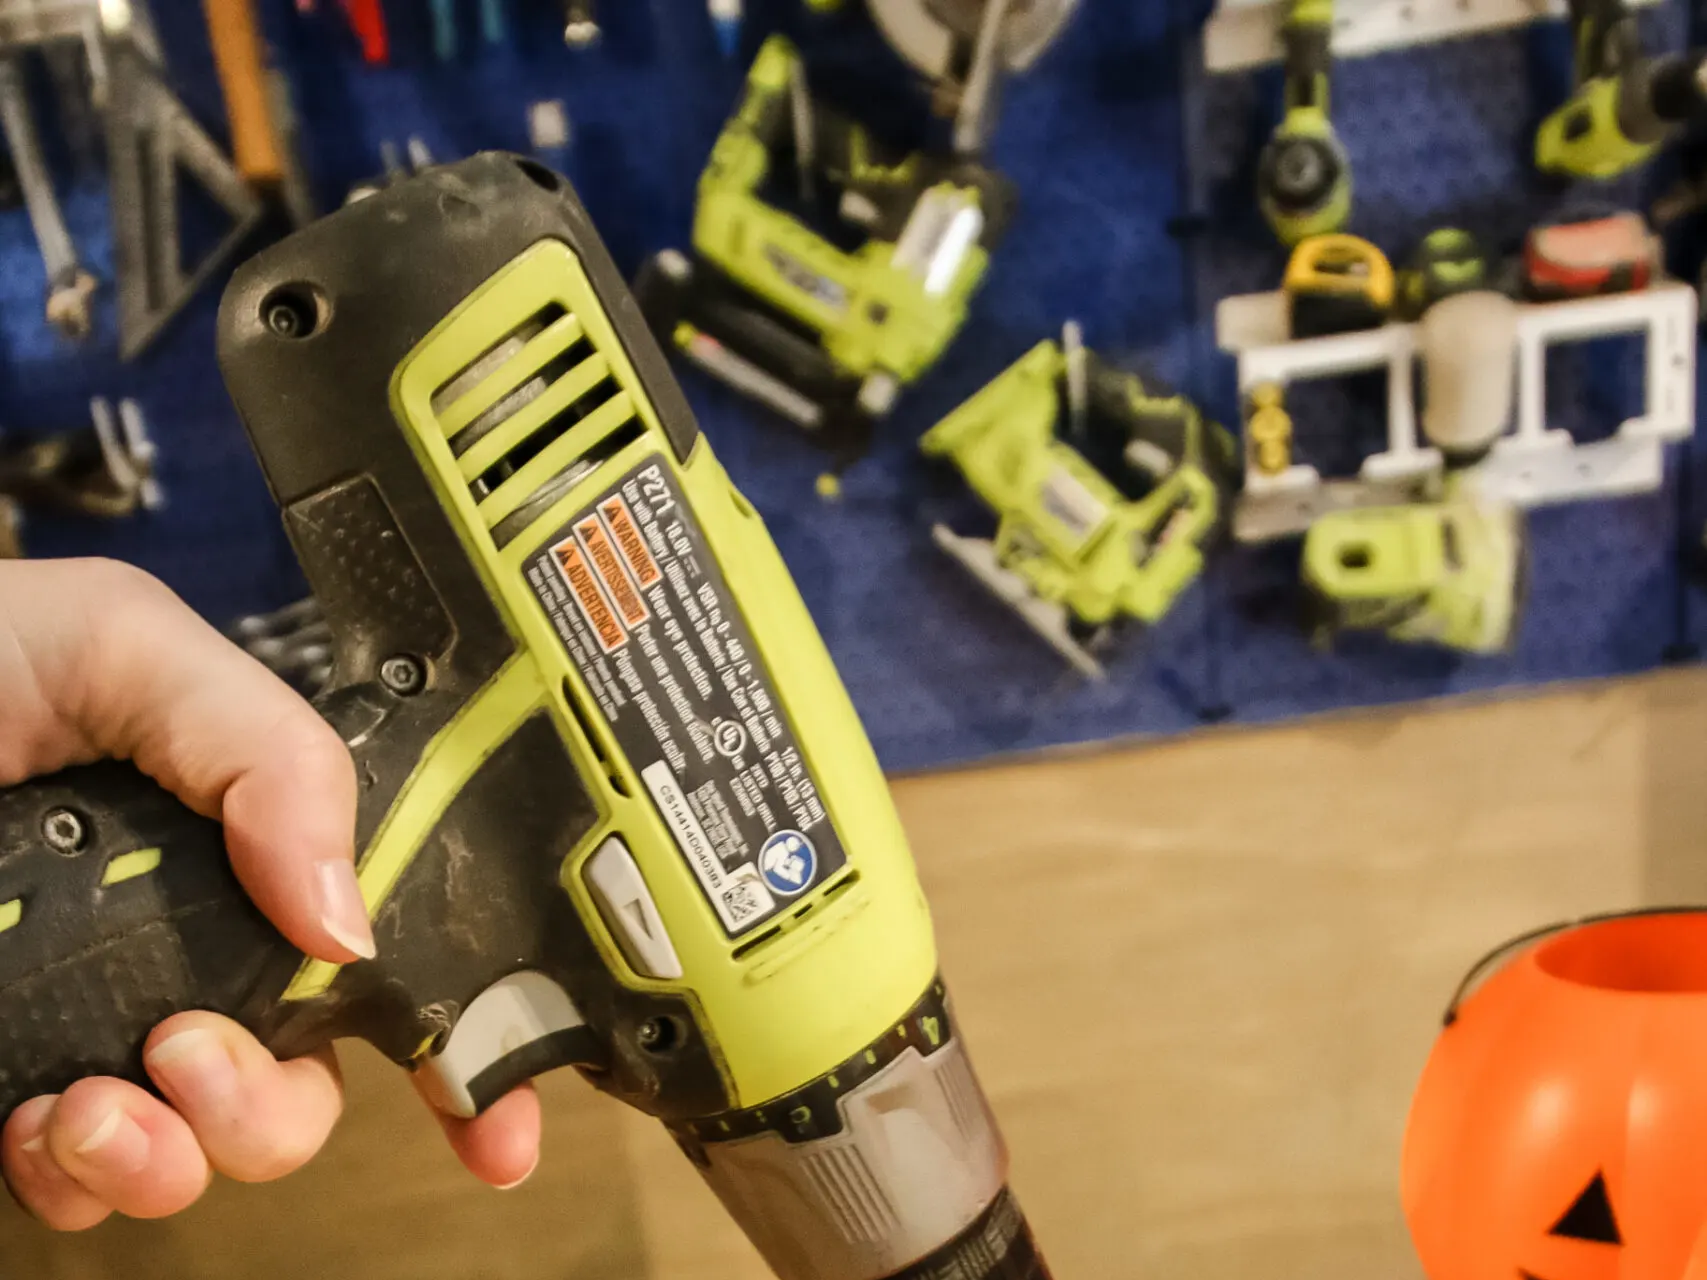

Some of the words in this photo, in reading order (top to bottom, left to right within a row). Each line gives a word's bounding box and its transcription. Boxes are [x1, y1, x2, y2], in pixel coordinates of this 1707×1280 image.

[621, 477, 643, 505] Use
[636, 460, 675, 518] P271
[632, 497, 654, 526] with
[641, 518, 671, 562] Battery
[663, 517, 693, 560] 18.0V
[663, 557, 693, 601] Utilisez
[613, 515, 655, 584] WARNING
[646, 584, 674, 622] Wear
[660, 616, 684, 645] eye
[672, 635, 716, 703] protection.
[681, 594, 702, 623] avec
[695, 579, 719, 612] VSR
[693, 616, 708, 633] le
[715, 619, 731, 635] 0
[634, 621, 662, 660] Porter
[699, 626, 728, 669] Batterie
[723, 634, 745, 662] 440
[565, 557, 623, 648] ADVERTENCIA
[608, 645, 646, 697] Póngase
[631, 685, 674, 745] protección
[660, 734, 690, 774] ocular.
[649, 653, 669, 679] une
[720, 666, 740, 692] Use
[737, 661, 753, 677] 0
[657, 671, 696, 727] protection
[729, 685, 750, 710] Con
[739, 703, 755, 721] el
[718, 725, 741, 751] UL
[763, 713, 784, 740] min
[685, 718, 717, 765] oculaire.
[779, 744, 798, 768] 1/2
[788, 762, 805, 781] in.
[739, 768, 763, 805] LISTED
[756, 801, 778, 832] DRILL
[794, 776, 815, 801] (13
[803, 794, 826, 824] mm)
